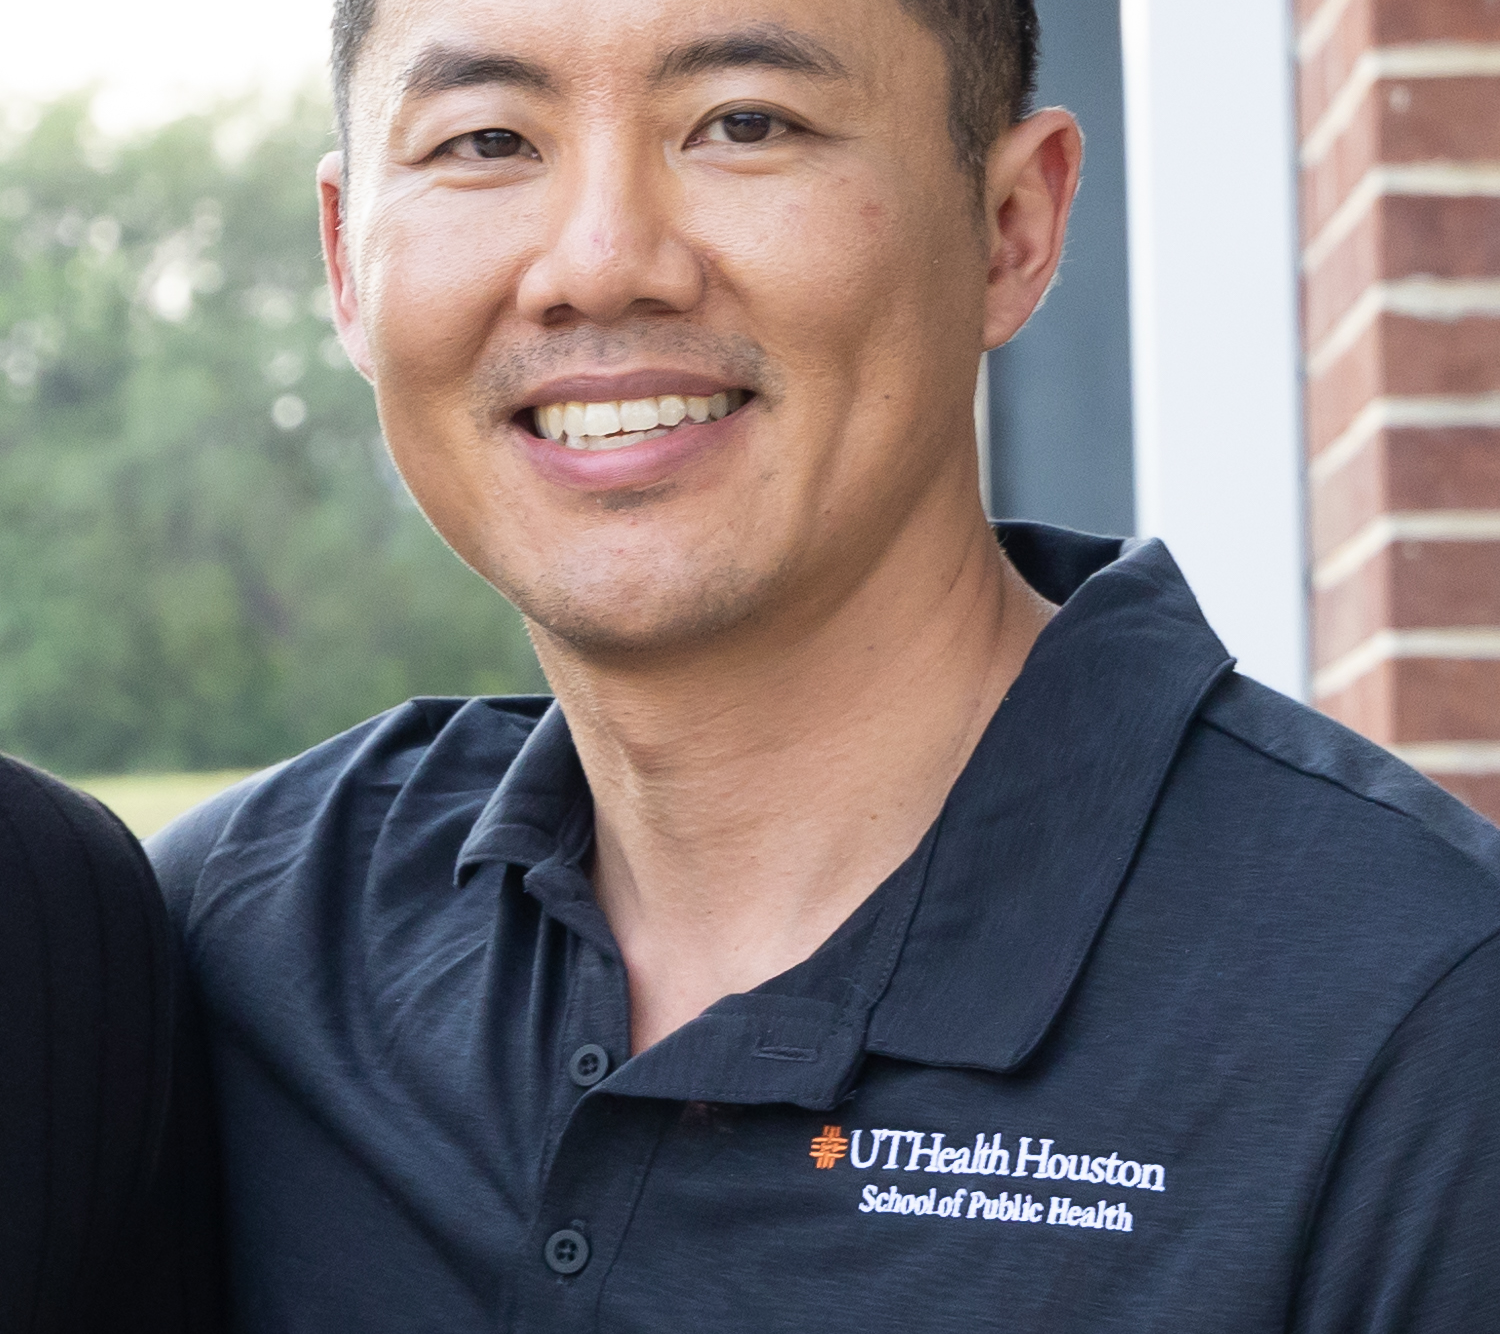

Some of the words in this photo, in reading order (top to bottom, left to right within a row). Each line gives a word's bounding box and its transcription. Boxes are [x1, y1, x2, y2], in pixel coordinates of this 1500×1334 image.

[850, 1129, 1010, 1175] UTHealth
[1011, 1137, 1166, 1192] Houston
[858, 1184, 938, 1216] School
[938, 1188, 968, 1218] of
[965, 1191, 1045, 1223] Public
[1046, 1196, 1134, 1232] Health
